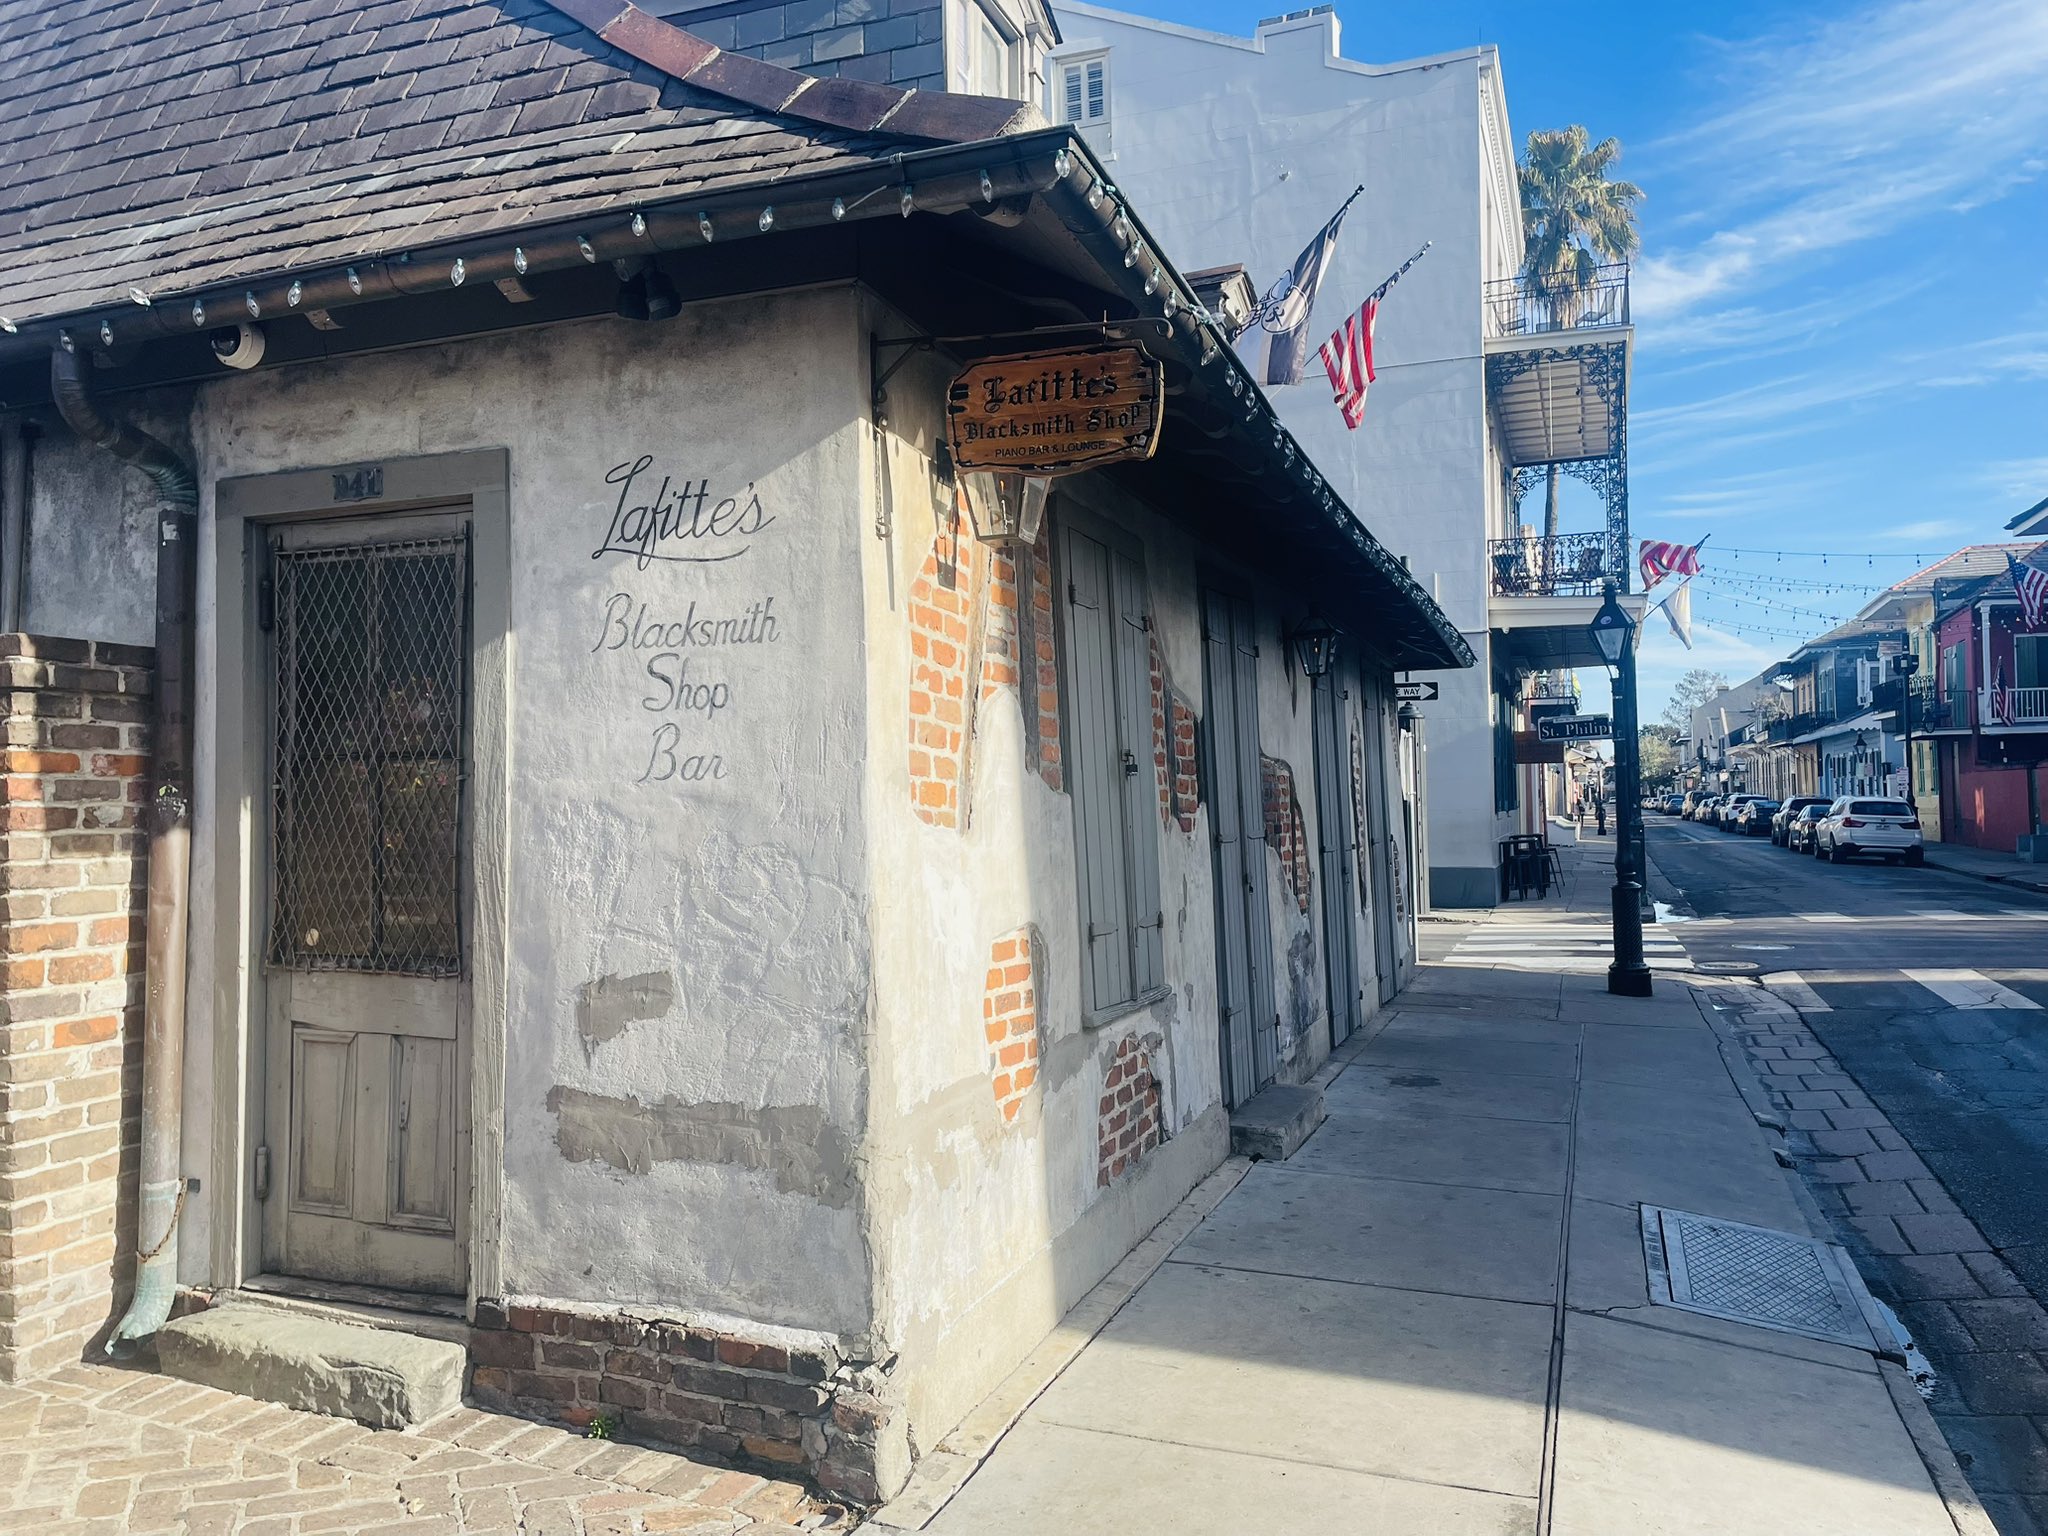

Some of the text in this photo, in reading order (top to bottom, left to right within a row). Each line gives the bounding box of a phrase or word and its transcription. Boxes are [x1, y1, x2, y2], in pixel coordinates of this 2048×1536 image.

[983, 367, 1119, 413] Lafitte's
[963, 405, 1139, 444] Blacksmith Shop
[995, 440, 1106, 458] PIANO BAR & LOUNGE
[592, 455, 775, 571] Lafitte's
[591, 592, 780, 652] Blacksmith
[641, 653, 728, 719] Shop
[1403, 688, 1420, 696] WAY
[1541, 721, 1608, 737] St. Philip
[637, 722, 727, 783] Bar
